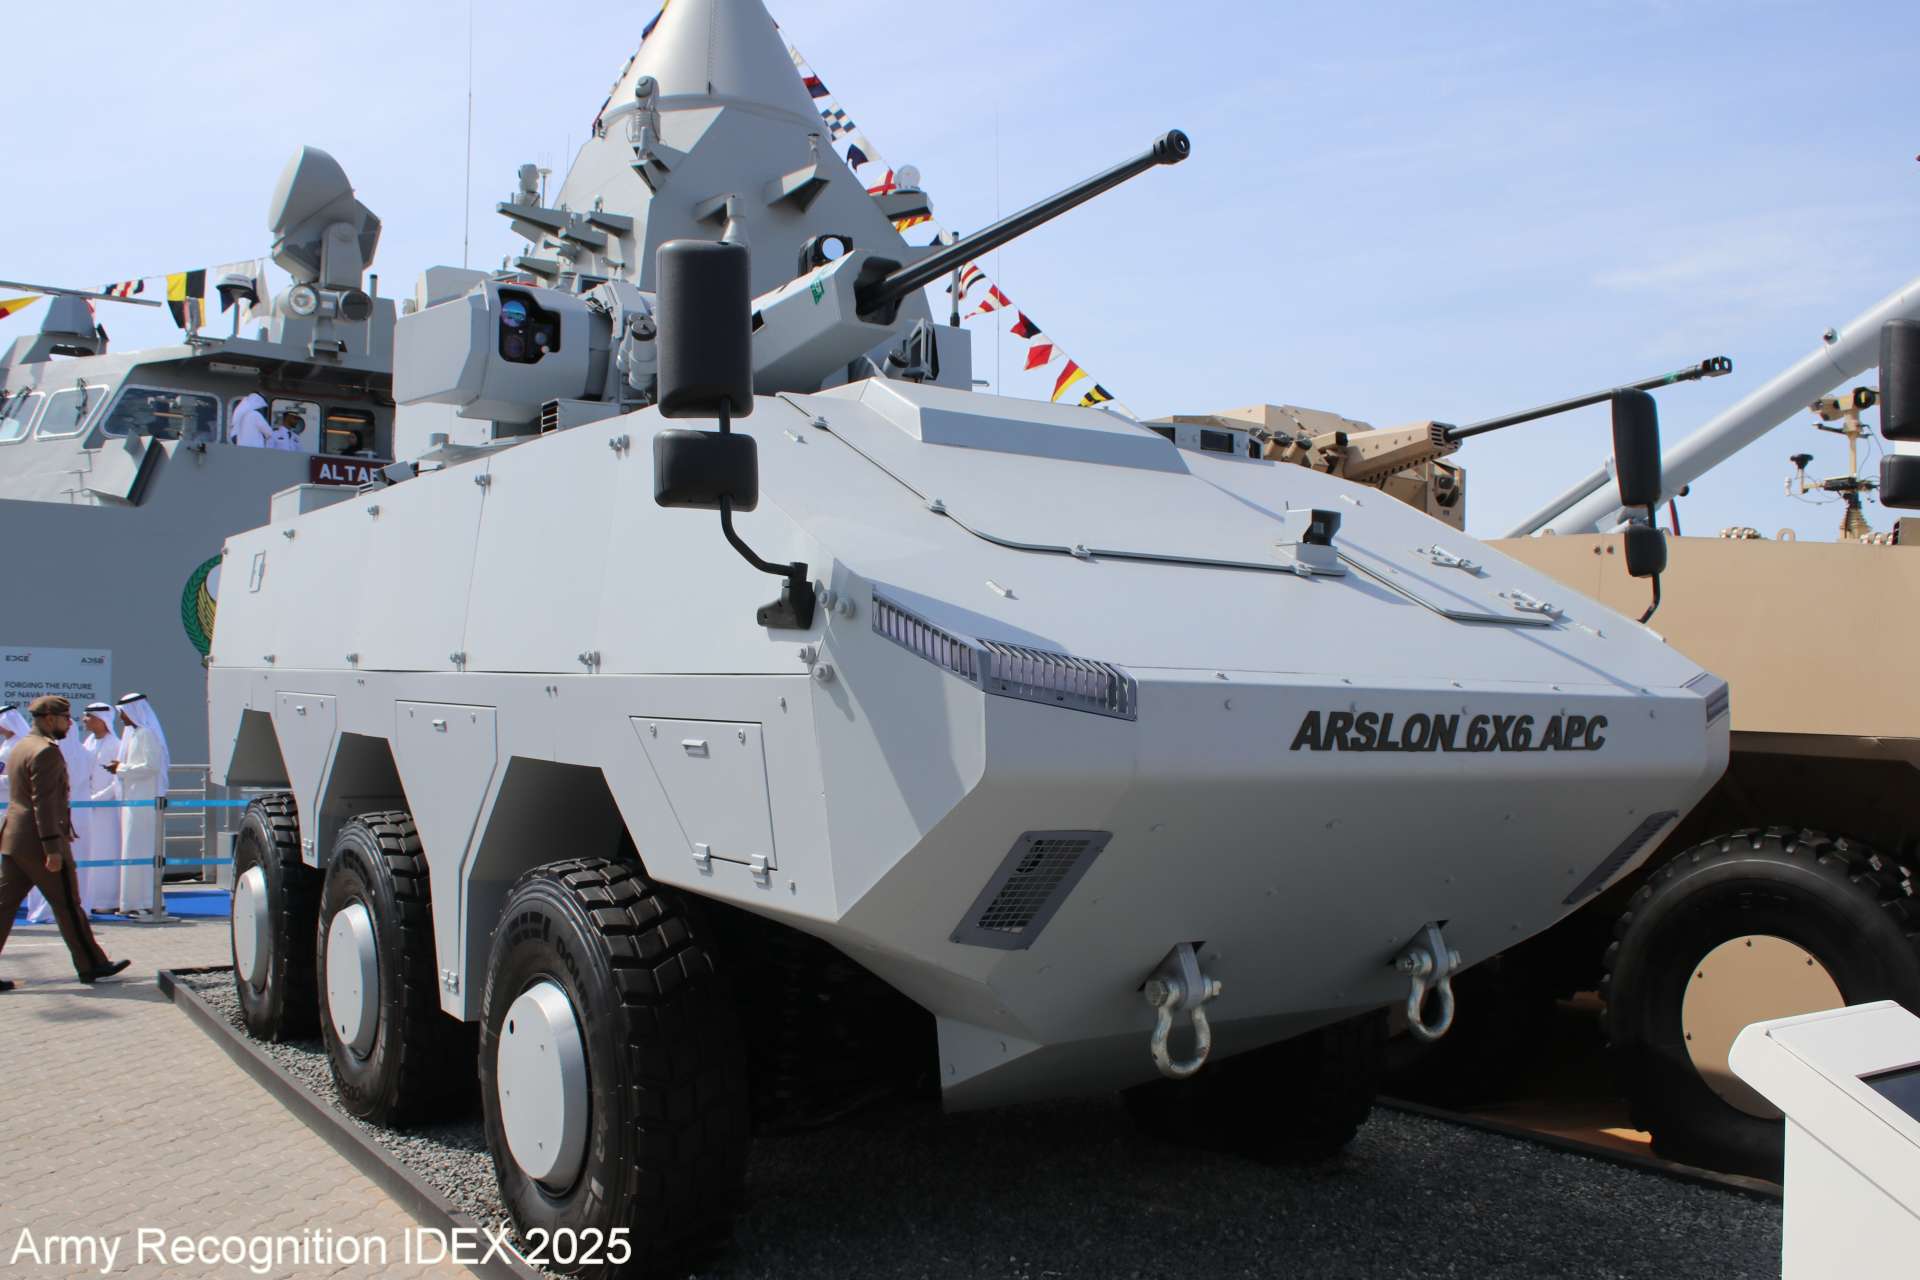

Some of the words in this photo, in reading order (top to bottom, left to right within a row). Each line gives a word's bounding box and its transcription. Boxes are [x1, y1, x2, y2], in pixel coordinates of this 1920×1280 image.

[5, 681, 44, 689] FORGING
[62, 682, 92, 690] FUTURE
[1290, 711, 1460, 752] ARSLON
[1466, 714, 1534, 752] 6X6
[1540, 714, 1608, 751] APC
